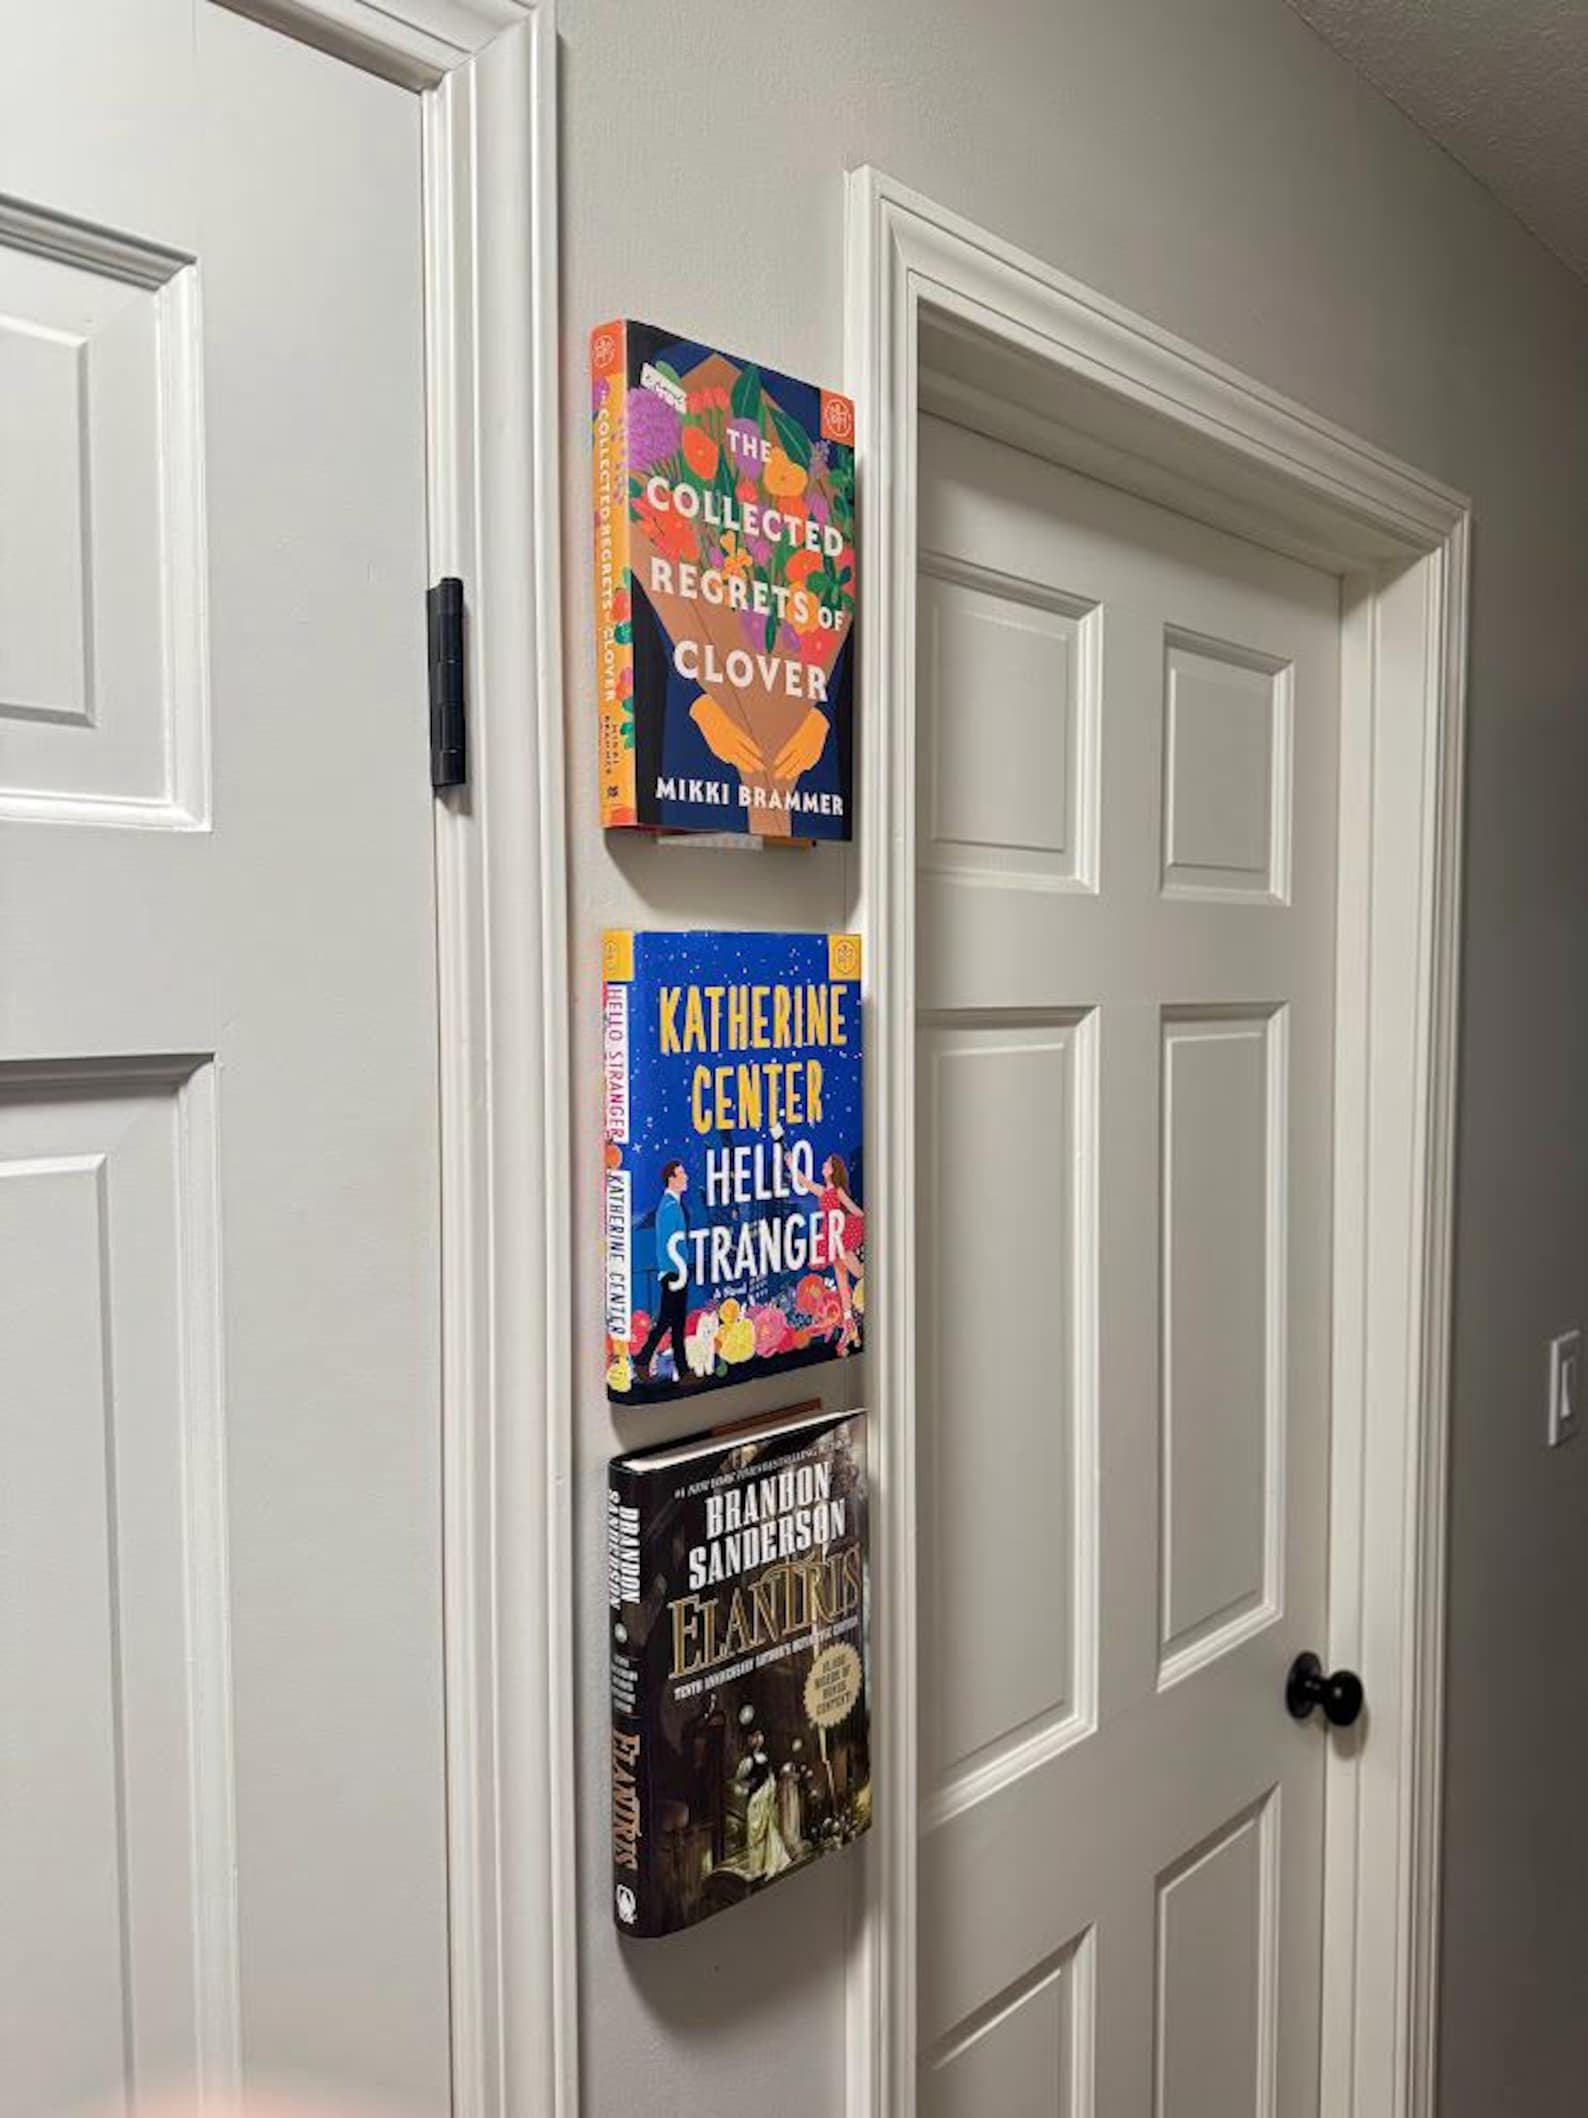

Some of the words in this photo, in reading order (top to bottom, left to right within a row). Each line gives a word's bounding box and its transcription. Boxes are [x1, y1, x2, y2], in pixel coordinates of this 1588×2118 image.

[599, 409, 611, 519] COLLECTED
[726, 427, 772, 463] THE
[647, 476, 843, 558] COLLECTED
[600, 523, 613, 610] REGRETS
[651, 556, 808, 624] REGRETS
[818, 610, 843, 631] OF
[604, 628, 617, 702] CLOVER
[673, 640, 828, 702] CLOVER
[655, 777, 729, 805] MIKKI
[738, 784, 843, 816] BRAMMER
[607, 988, 623, 1042] HELLO
[660, 984, 848, 1054] KATHERINE
[607, 1051, 626, 1139] STRANGER
[692, 1060, 823, 1134] CENTER
[706, 1140, 813, 1207] HELLO
[607, 1174, 626, 1262] KATHERINE
[666, 1209, 846, 1292] STRANGER
[609, 1272, 626, 1335] CENTER
[705, 1461, 832, 1540] BRANDON
[608, 1488, 622, 1610] SANDERSON
[619, 1506, 641, 1604] BRANDON
[688, 1498, 846, 1591] SANDERSON
[667, 1541, 861, 1681] ELANTRIS
[674, 1680, 703, 1701] TENTH
[613, 1728, 642, 1871] ELANTRIS
